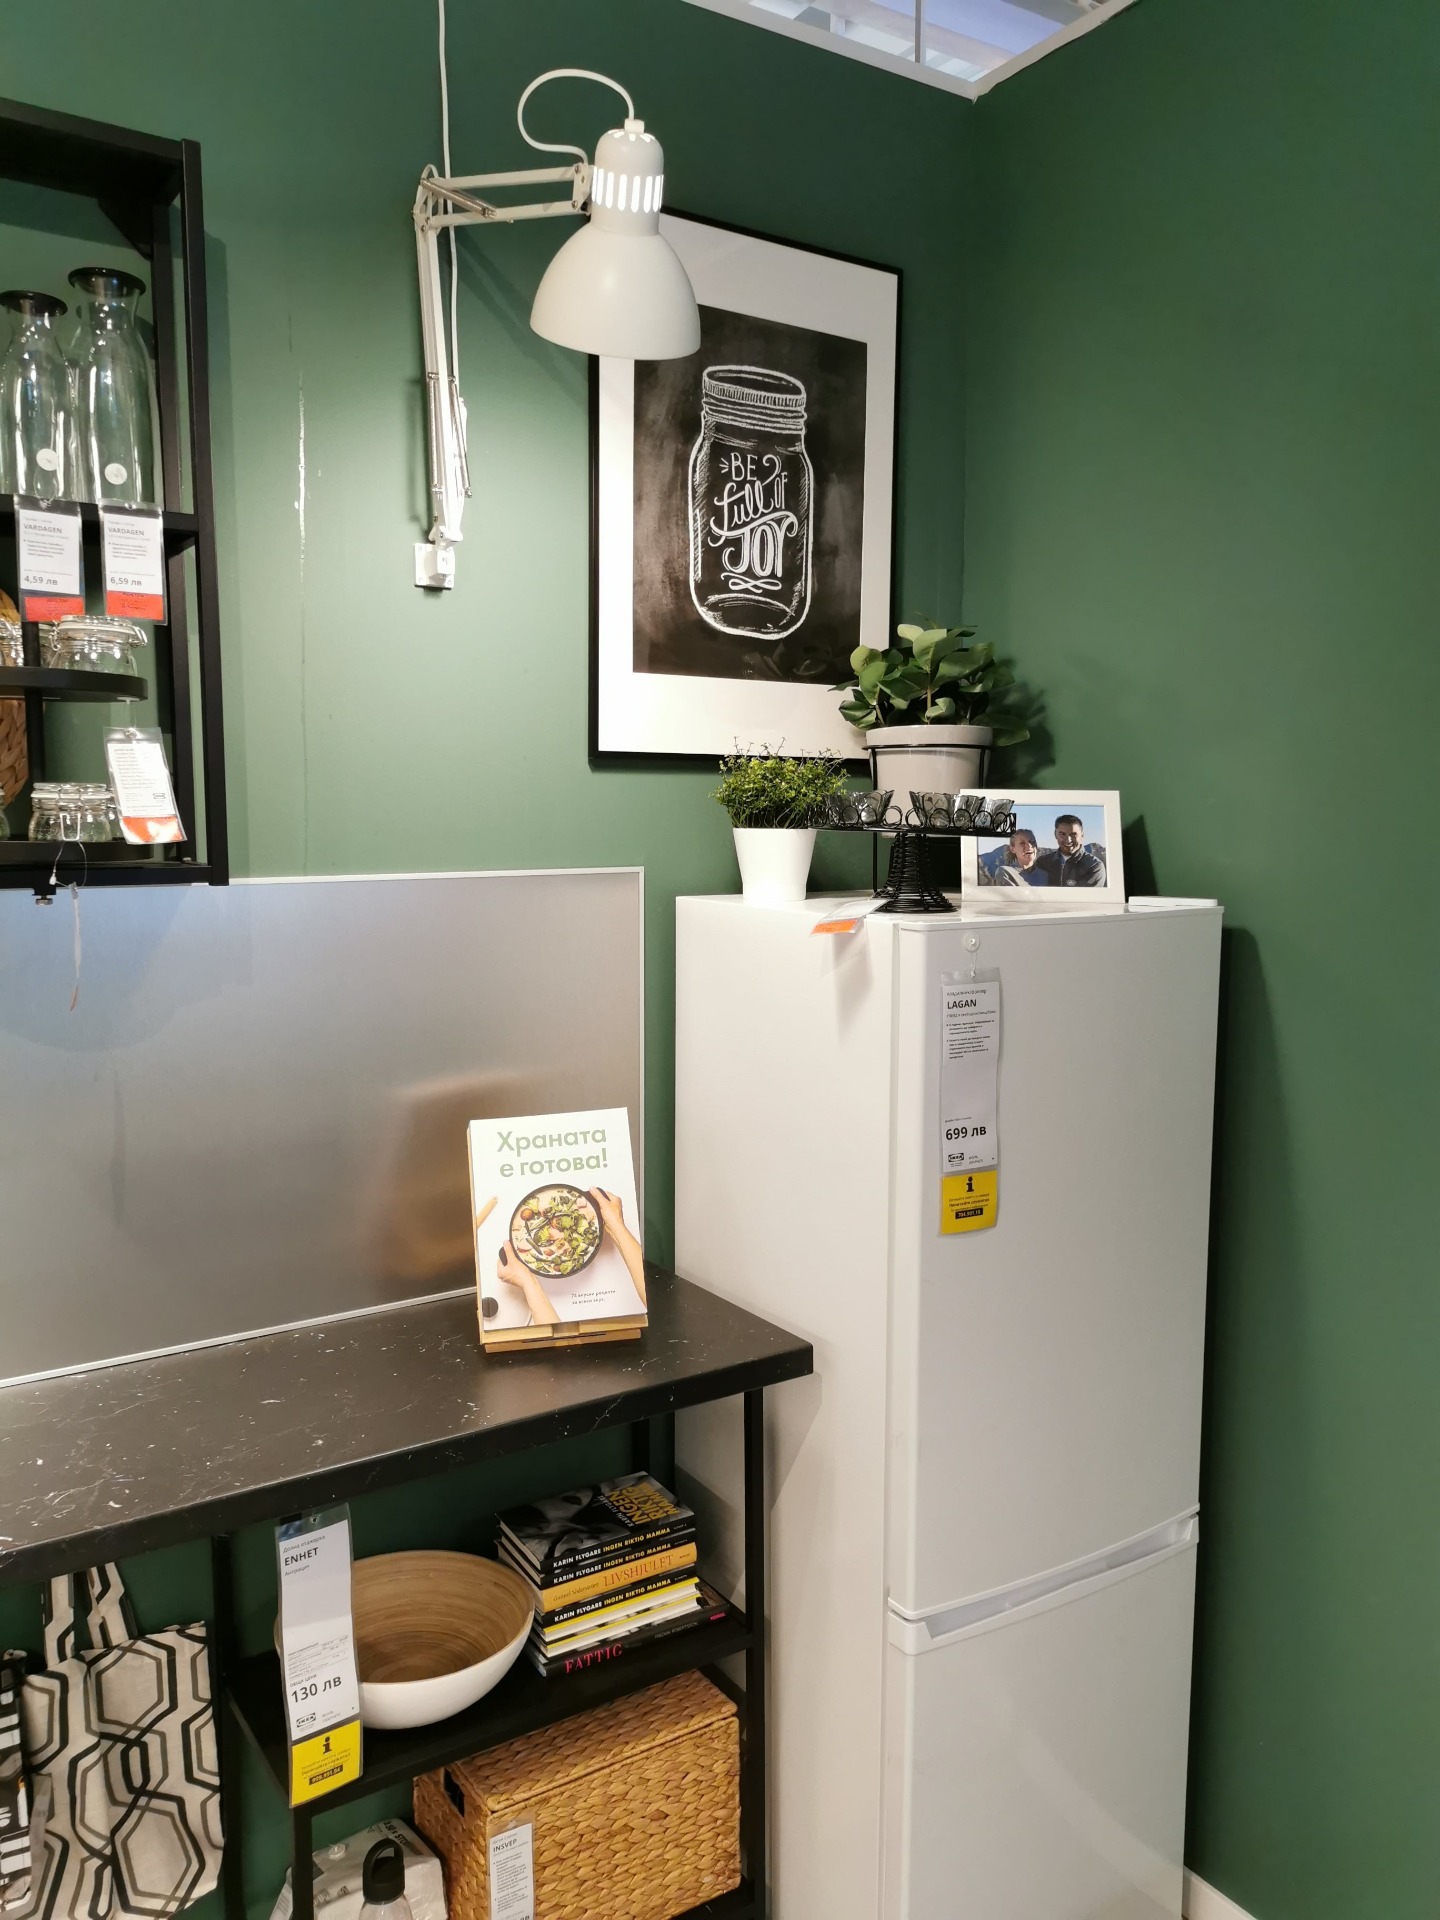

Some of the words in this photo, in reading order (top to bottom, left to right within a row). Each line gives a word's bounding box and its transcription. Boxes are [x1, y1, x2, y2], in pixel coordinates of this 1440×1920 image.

[731, 453, 758, 481] BE
[774, 472, 788, 509] OF
[24, 523, 63, 534] VARDAGEN
[108, 527, 145, 536] VARDAGEN
[24, 575, 44, 585] 4,59
[110, 577, 129, 585] 6,59
[947, 999, 977, 1010] LAGAN
[497, 1128, 607, 1157] Храната
[945, 1126, 968, 1140] 699
[500, 1163, 514, 1178] е
[520, 1148, 608, 1176] готова!
[285, 1547, 318, 1566] ENHET
[553, 1558, 574, 1568] KARIN
[576, 1549, 602, 1561] FLYGARE
[603, 1542, 623, 1552] INGEN
[624, 1536, 645, 1546] RIKTIG
[646, 1527, 671, 1539] MAMMA
[553, 1573, 574, 1584] KARIN
[576, 1565, 602, 1577] FLYGARE
[604, 1558, 623, 1568] INGEN
[625, 1551, 645, 1561] RIKTIG
[646, 1543, 672, 1555] MAMMA
[603, 1554, 674, 1587] LIVSHJULET
[554, 1610, 575, 1622] KARIN
[576, 1602, 602, 1615] FLYGARE
[604, 1594, 624, 1606] INGEN
[626, 1587, 646, 1598] RIKTIG
[646, 1579, 672, 1591] MAMMA
[564, 1643, 624, 1674] FATTIG
[292, 1683, 318, 1703] 130
